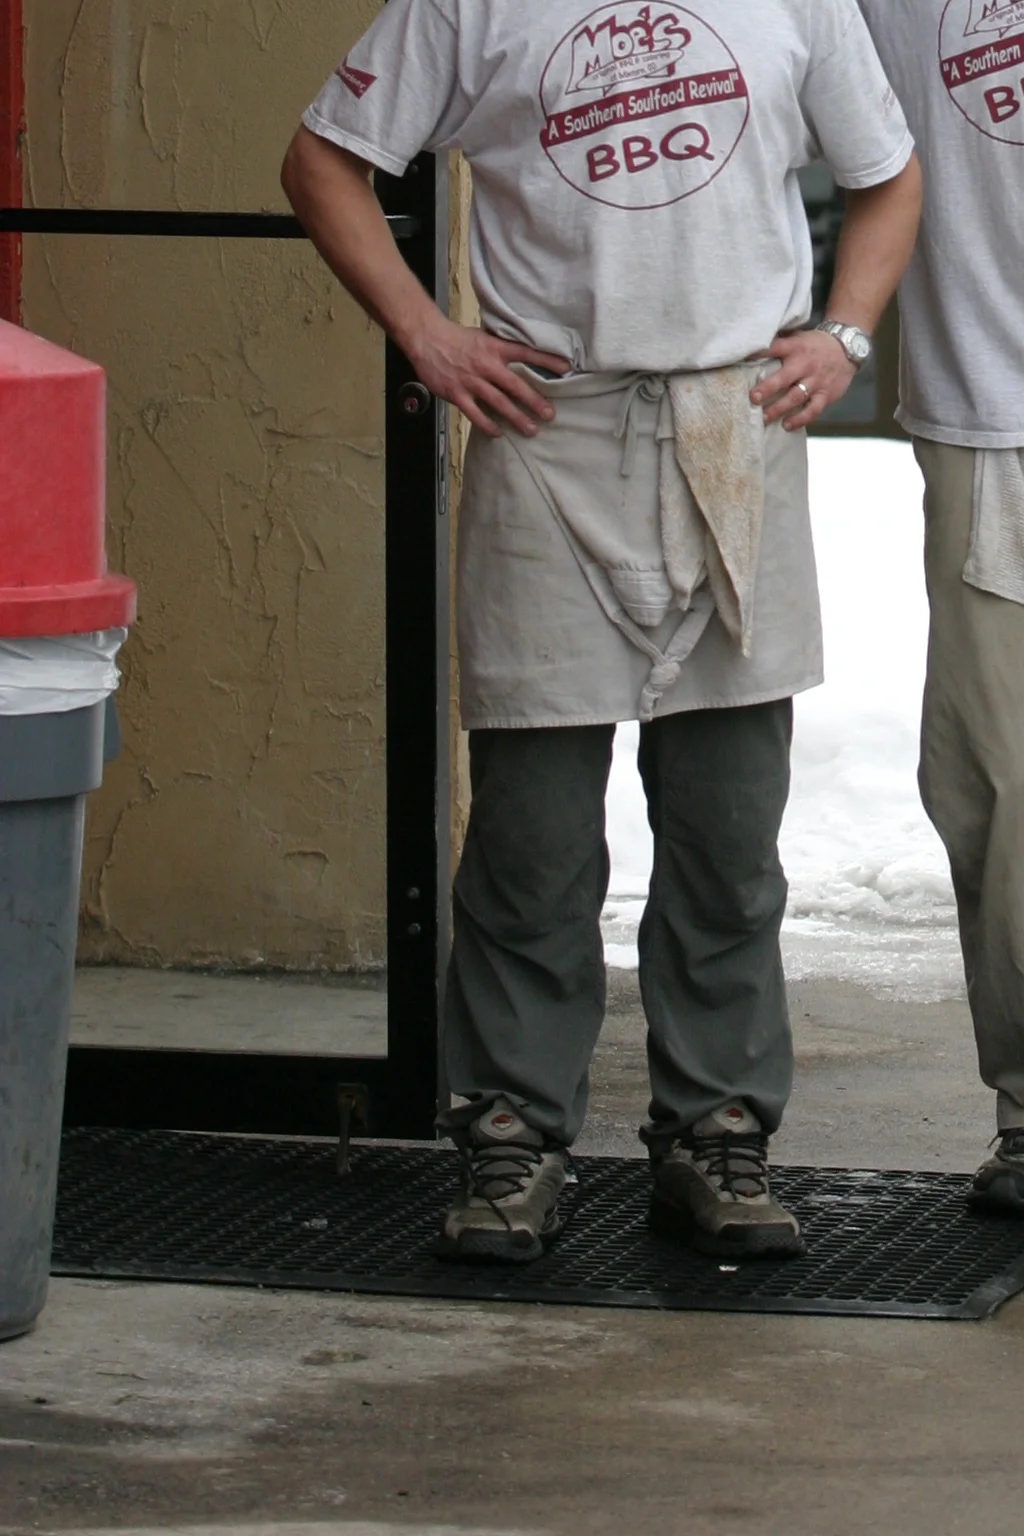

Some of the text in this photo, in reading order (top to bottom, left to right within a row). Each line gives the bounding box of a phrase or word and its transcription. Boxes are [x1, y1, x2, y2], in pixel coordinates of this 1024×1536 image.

[565, 5, 692, 97] Moe's
[965, 42, 1021, 77] Southern
[563, 100, 625, 135] Southern
[628, 81, 685, 115] Soulfood
[586, 122, 716, 183] BBQ
